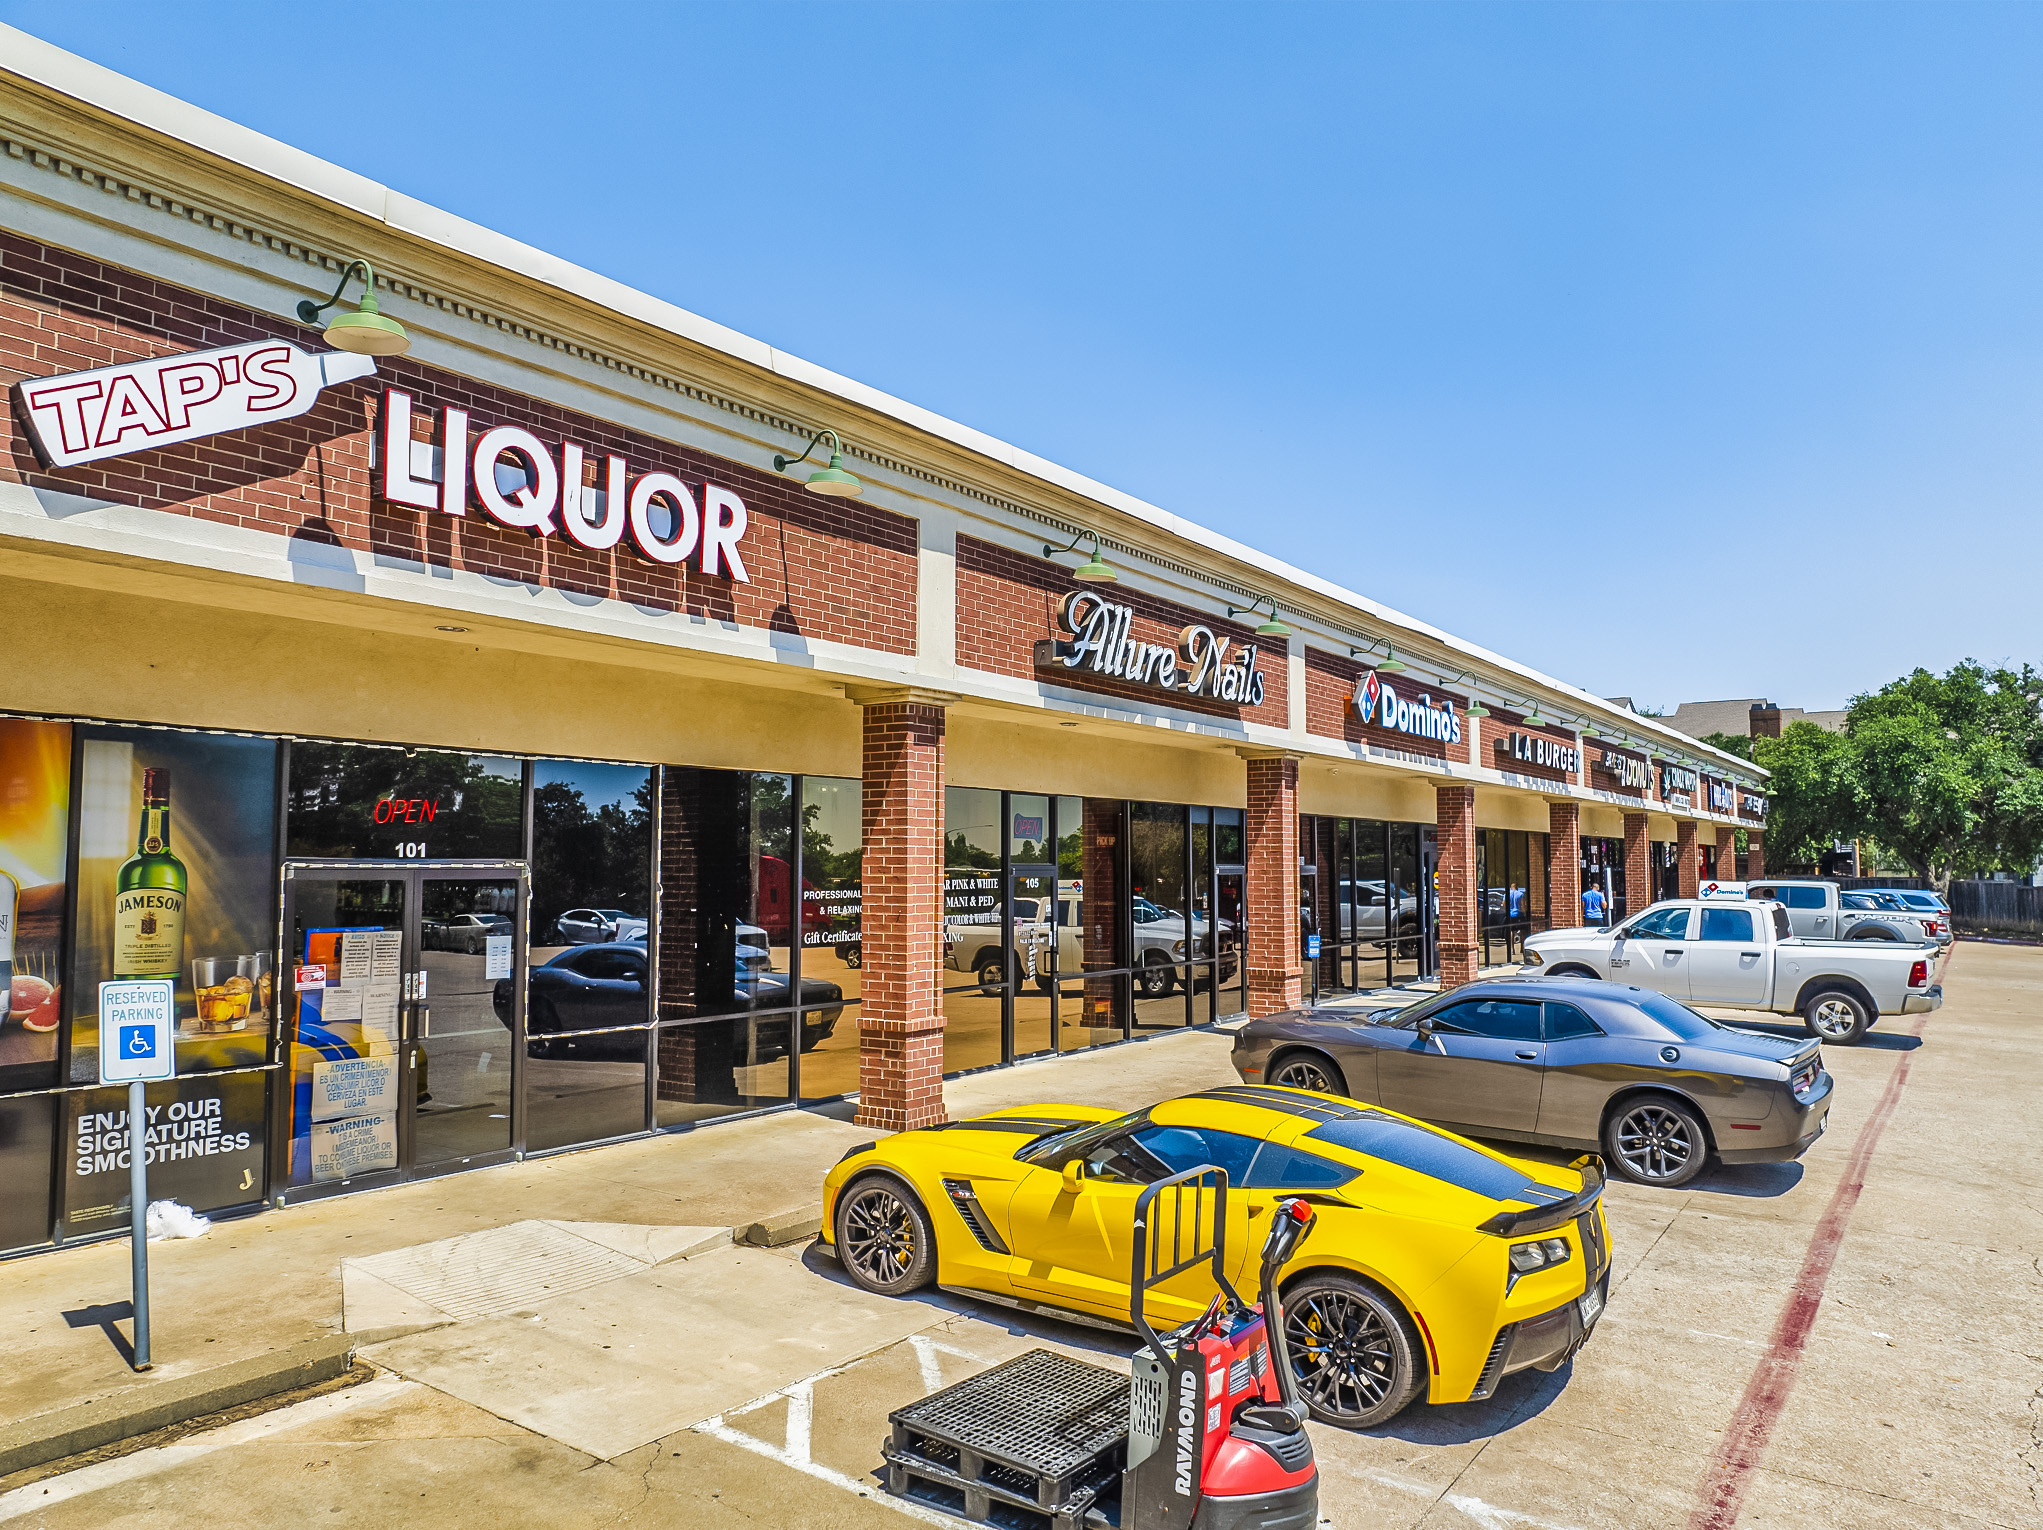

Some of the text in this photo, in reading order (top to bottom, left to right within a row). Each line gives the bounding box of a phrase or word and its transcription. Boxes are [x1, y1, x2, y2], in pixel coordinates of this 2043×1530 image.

[29, 347, 297, 454] TAP'S
[384, 388, 751, 584] LIQUOR
[1062, 591, 1265, 706] Allure Nails
[1380, 683, 1461, 744] Domino's
[1536, 738, 1580, 773] BURGER
[1626, 757, 1655, 790] DONUTS
[374, 799, 437, 824] OPEN
[1014, 819, 1039, 835] OPEN
[395, 842, 426, 857] 101
[952, 879, 969, 889] PINK
[970, 879, 975, 889] &
[977, 879, 999, 889] WHITE
[1025, 878, 1039, 889] 105
[804, 890, 862, 899] PROFESSIONAL
[119, 896, 182, 913] JAMESON
[946, 896, 994, 907] MANI & PED
[820, 907, 825, 915] &
[1854, 914, 1911, 922] RAPTOR
[804, 931, 820, 944] Gift
[943, 932, 964, 943] XING
[107, 992, 166, 1005] RESERVED
[112, 1008, 162, 1021] PARKING
[320, 1075, 328, 1084] ES
[340, 1071, 364, 1081] CRIMEN
[361, 1078, 380, 1088] LICOR
[381, 1077, 386, 1085] O
[328, 1087, 383, 1101] CERVEZA EN ESTE
[77, 1098, 221, 1134] ENJY OUR
[354, 1127, 374, 1137] CRIME
[318, 1154, 328, 1163] TO
[357, 1143, 380, 1154] LIQUOR
[382, 1142, 392, 1150] OR
[314, 1163, 334, 1173] BEER
[1175, 1370, 1196, 1496] RAYMOND
